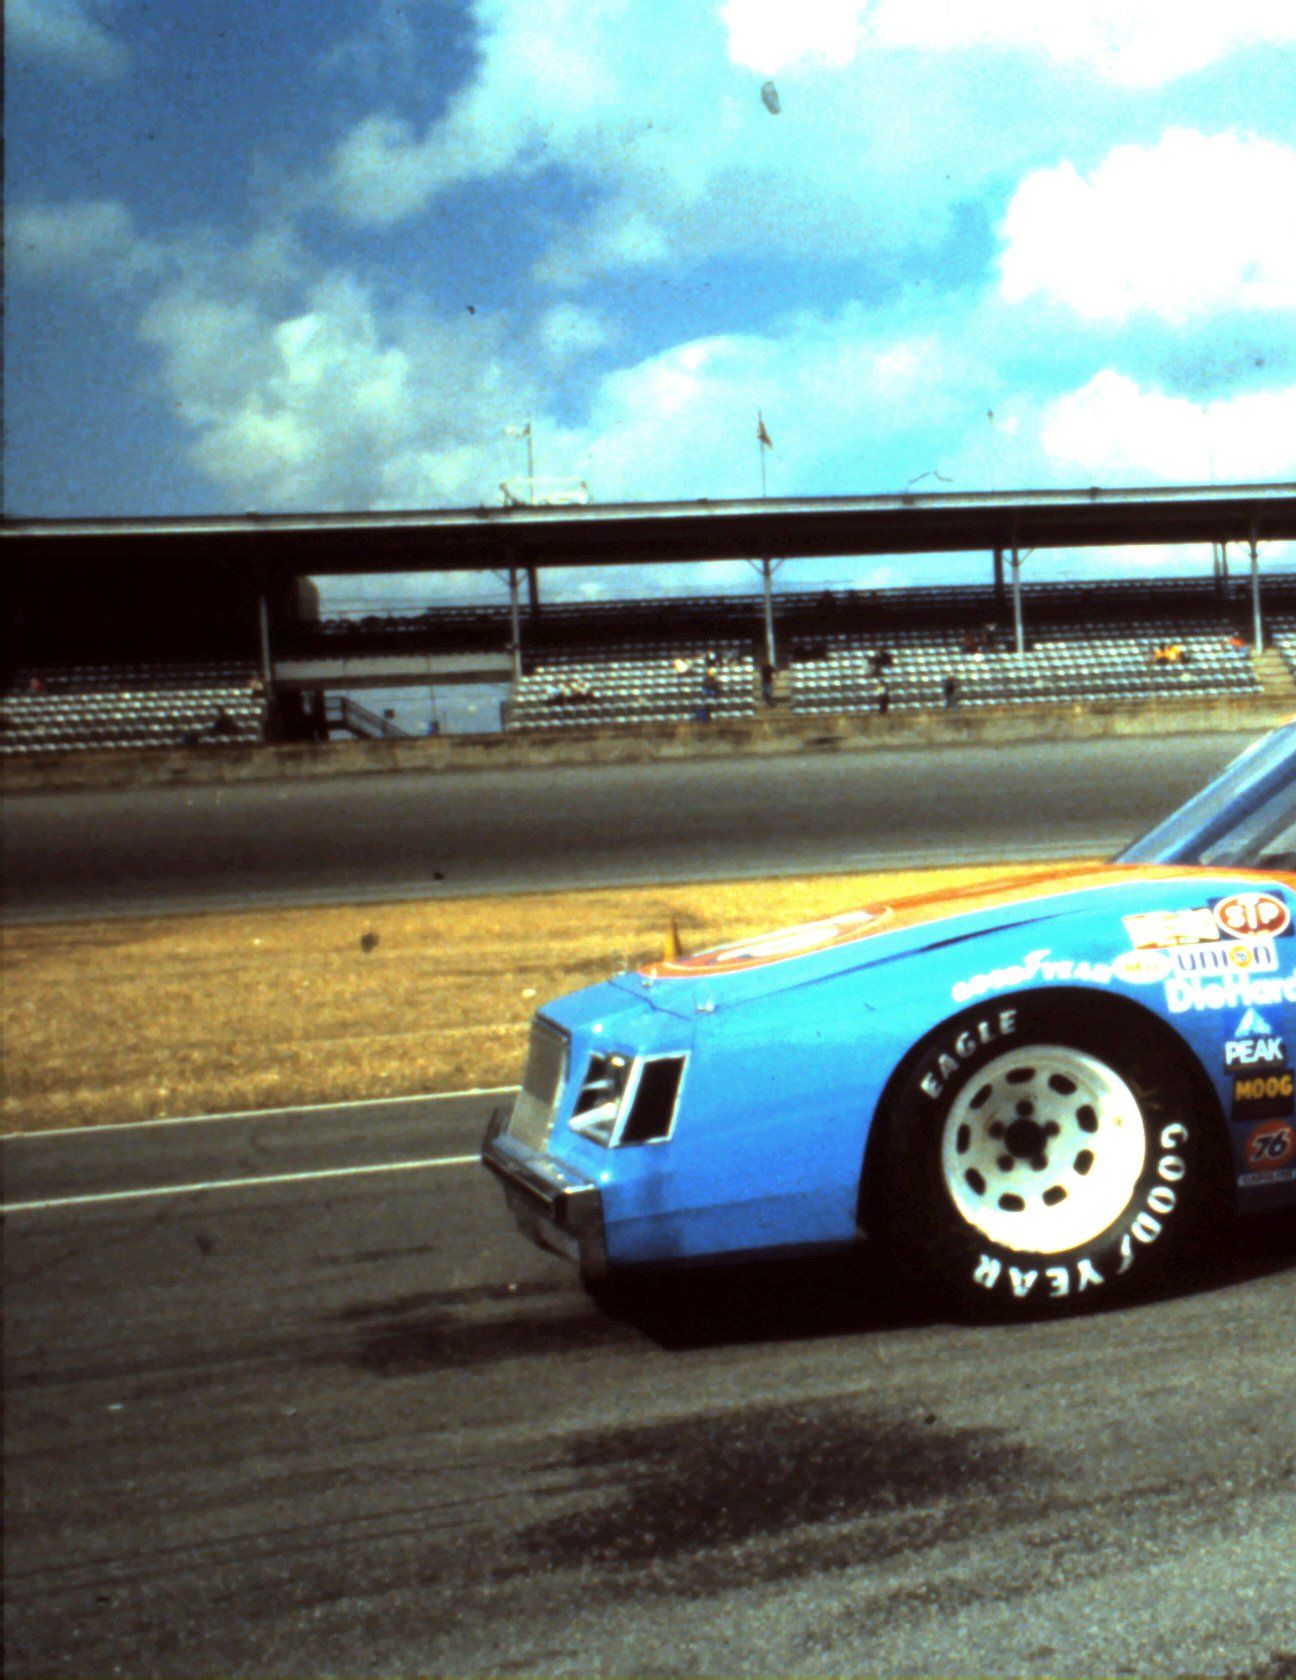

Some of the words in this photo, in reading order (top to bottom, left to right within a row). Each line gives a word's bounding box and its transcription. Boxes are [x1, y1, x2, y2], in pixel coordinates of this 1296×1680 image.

[1224, 893, 1281, 931] STP
[920, 1009, 1019, 1100] EAGLE
[1224, 1036, 1284, 1066] PEAK
[1234, 1074, 1294, 1101] MOOG
[1250, 1127, 1292, 1162] 76
